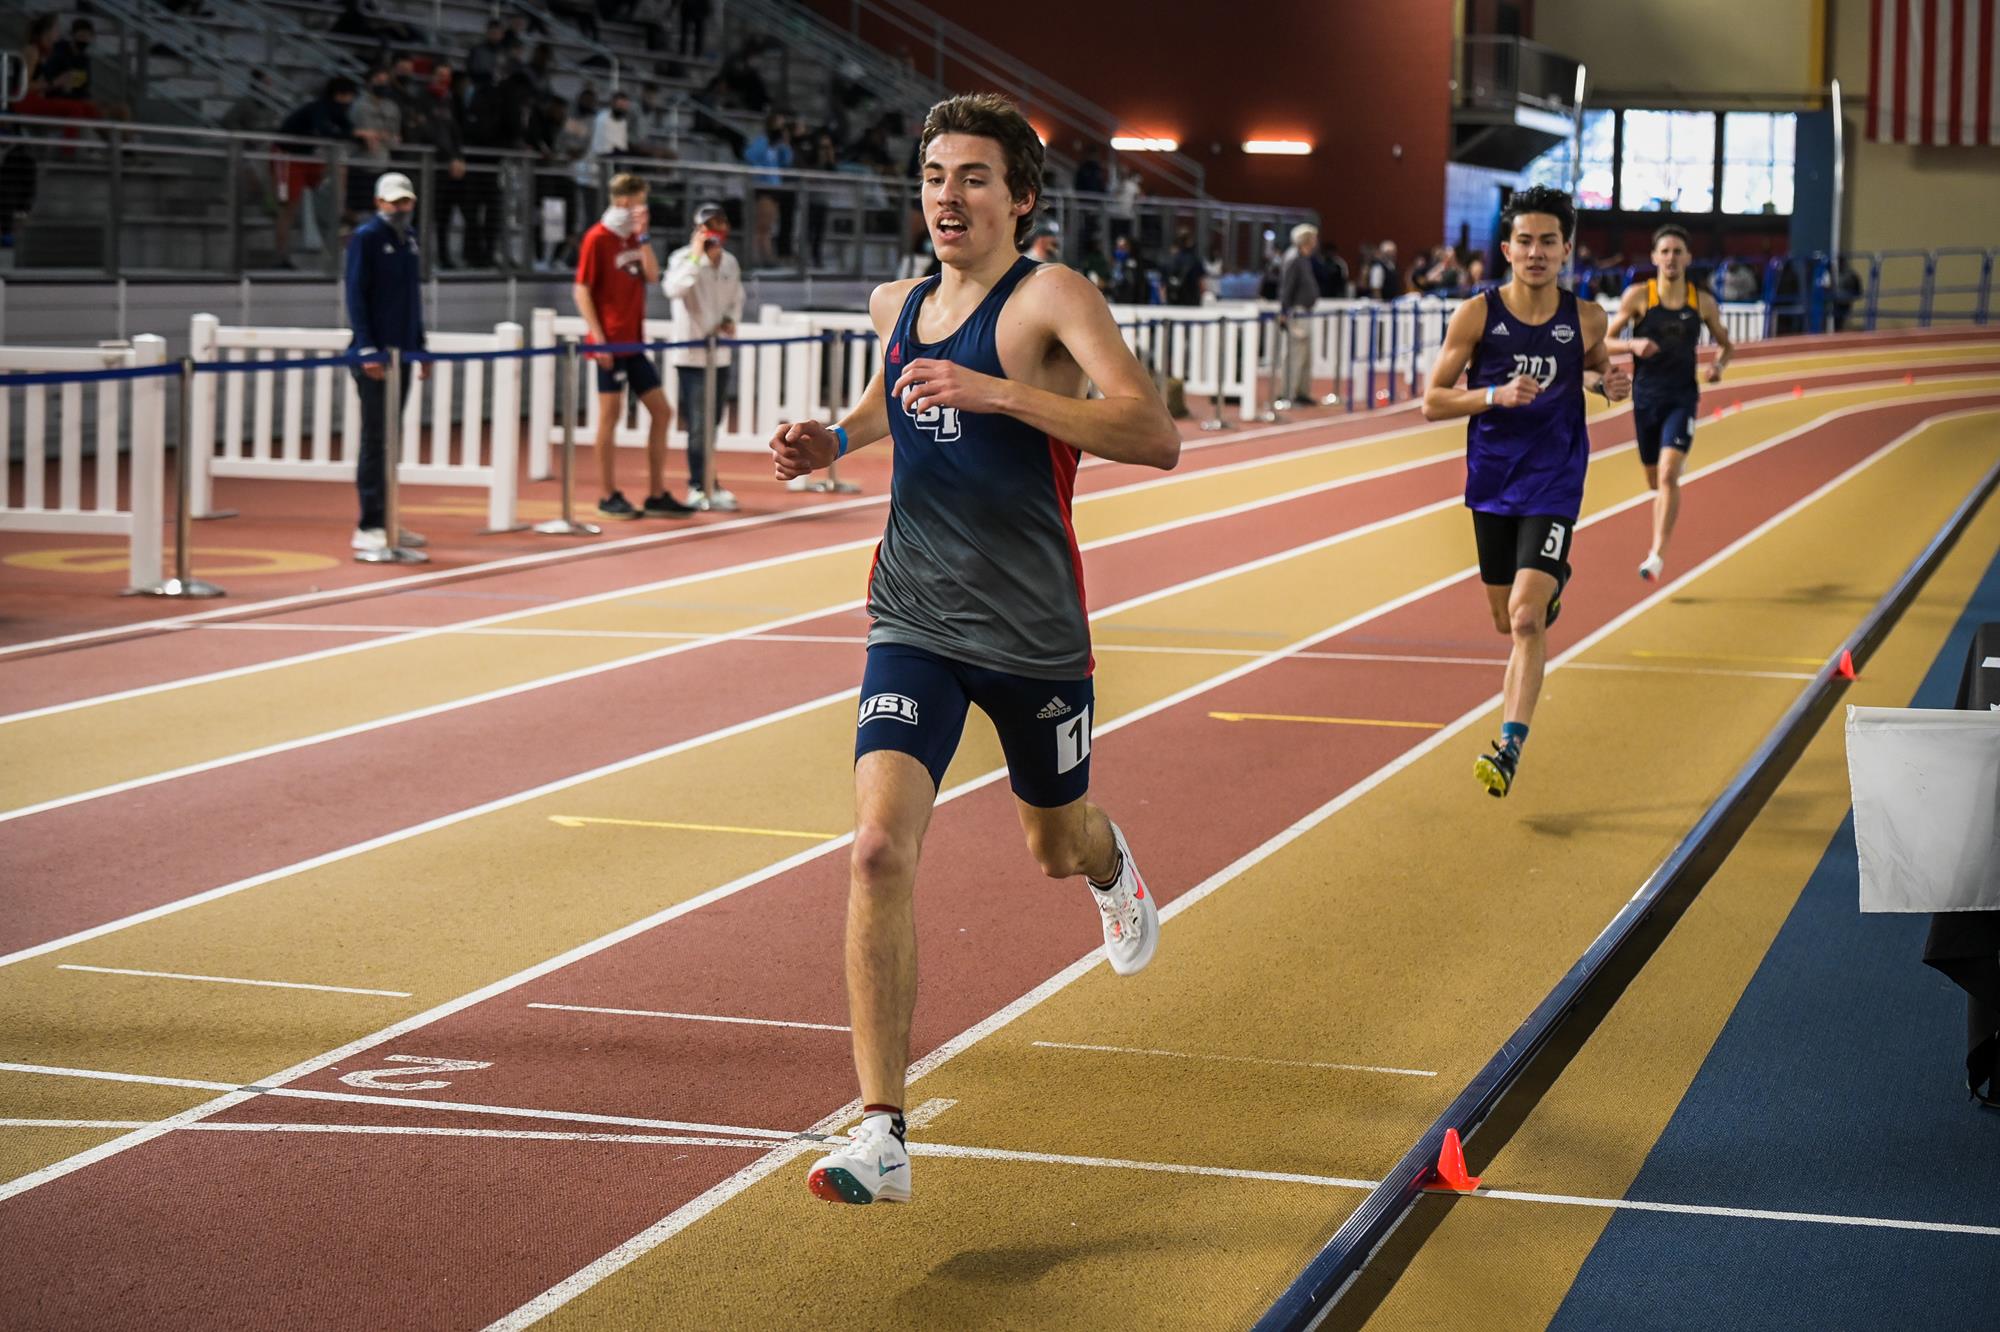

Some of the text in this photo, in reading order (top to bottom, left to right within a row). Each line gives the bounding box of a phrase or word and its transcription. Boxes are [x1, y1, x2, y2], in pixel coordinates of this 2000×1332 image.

[859, 695, 915, 723] USI
[1036, 705, 1072, 719] adidas
[1068, 716, 1083, 762] 1
[338, 1055, 495, 1091] 2
